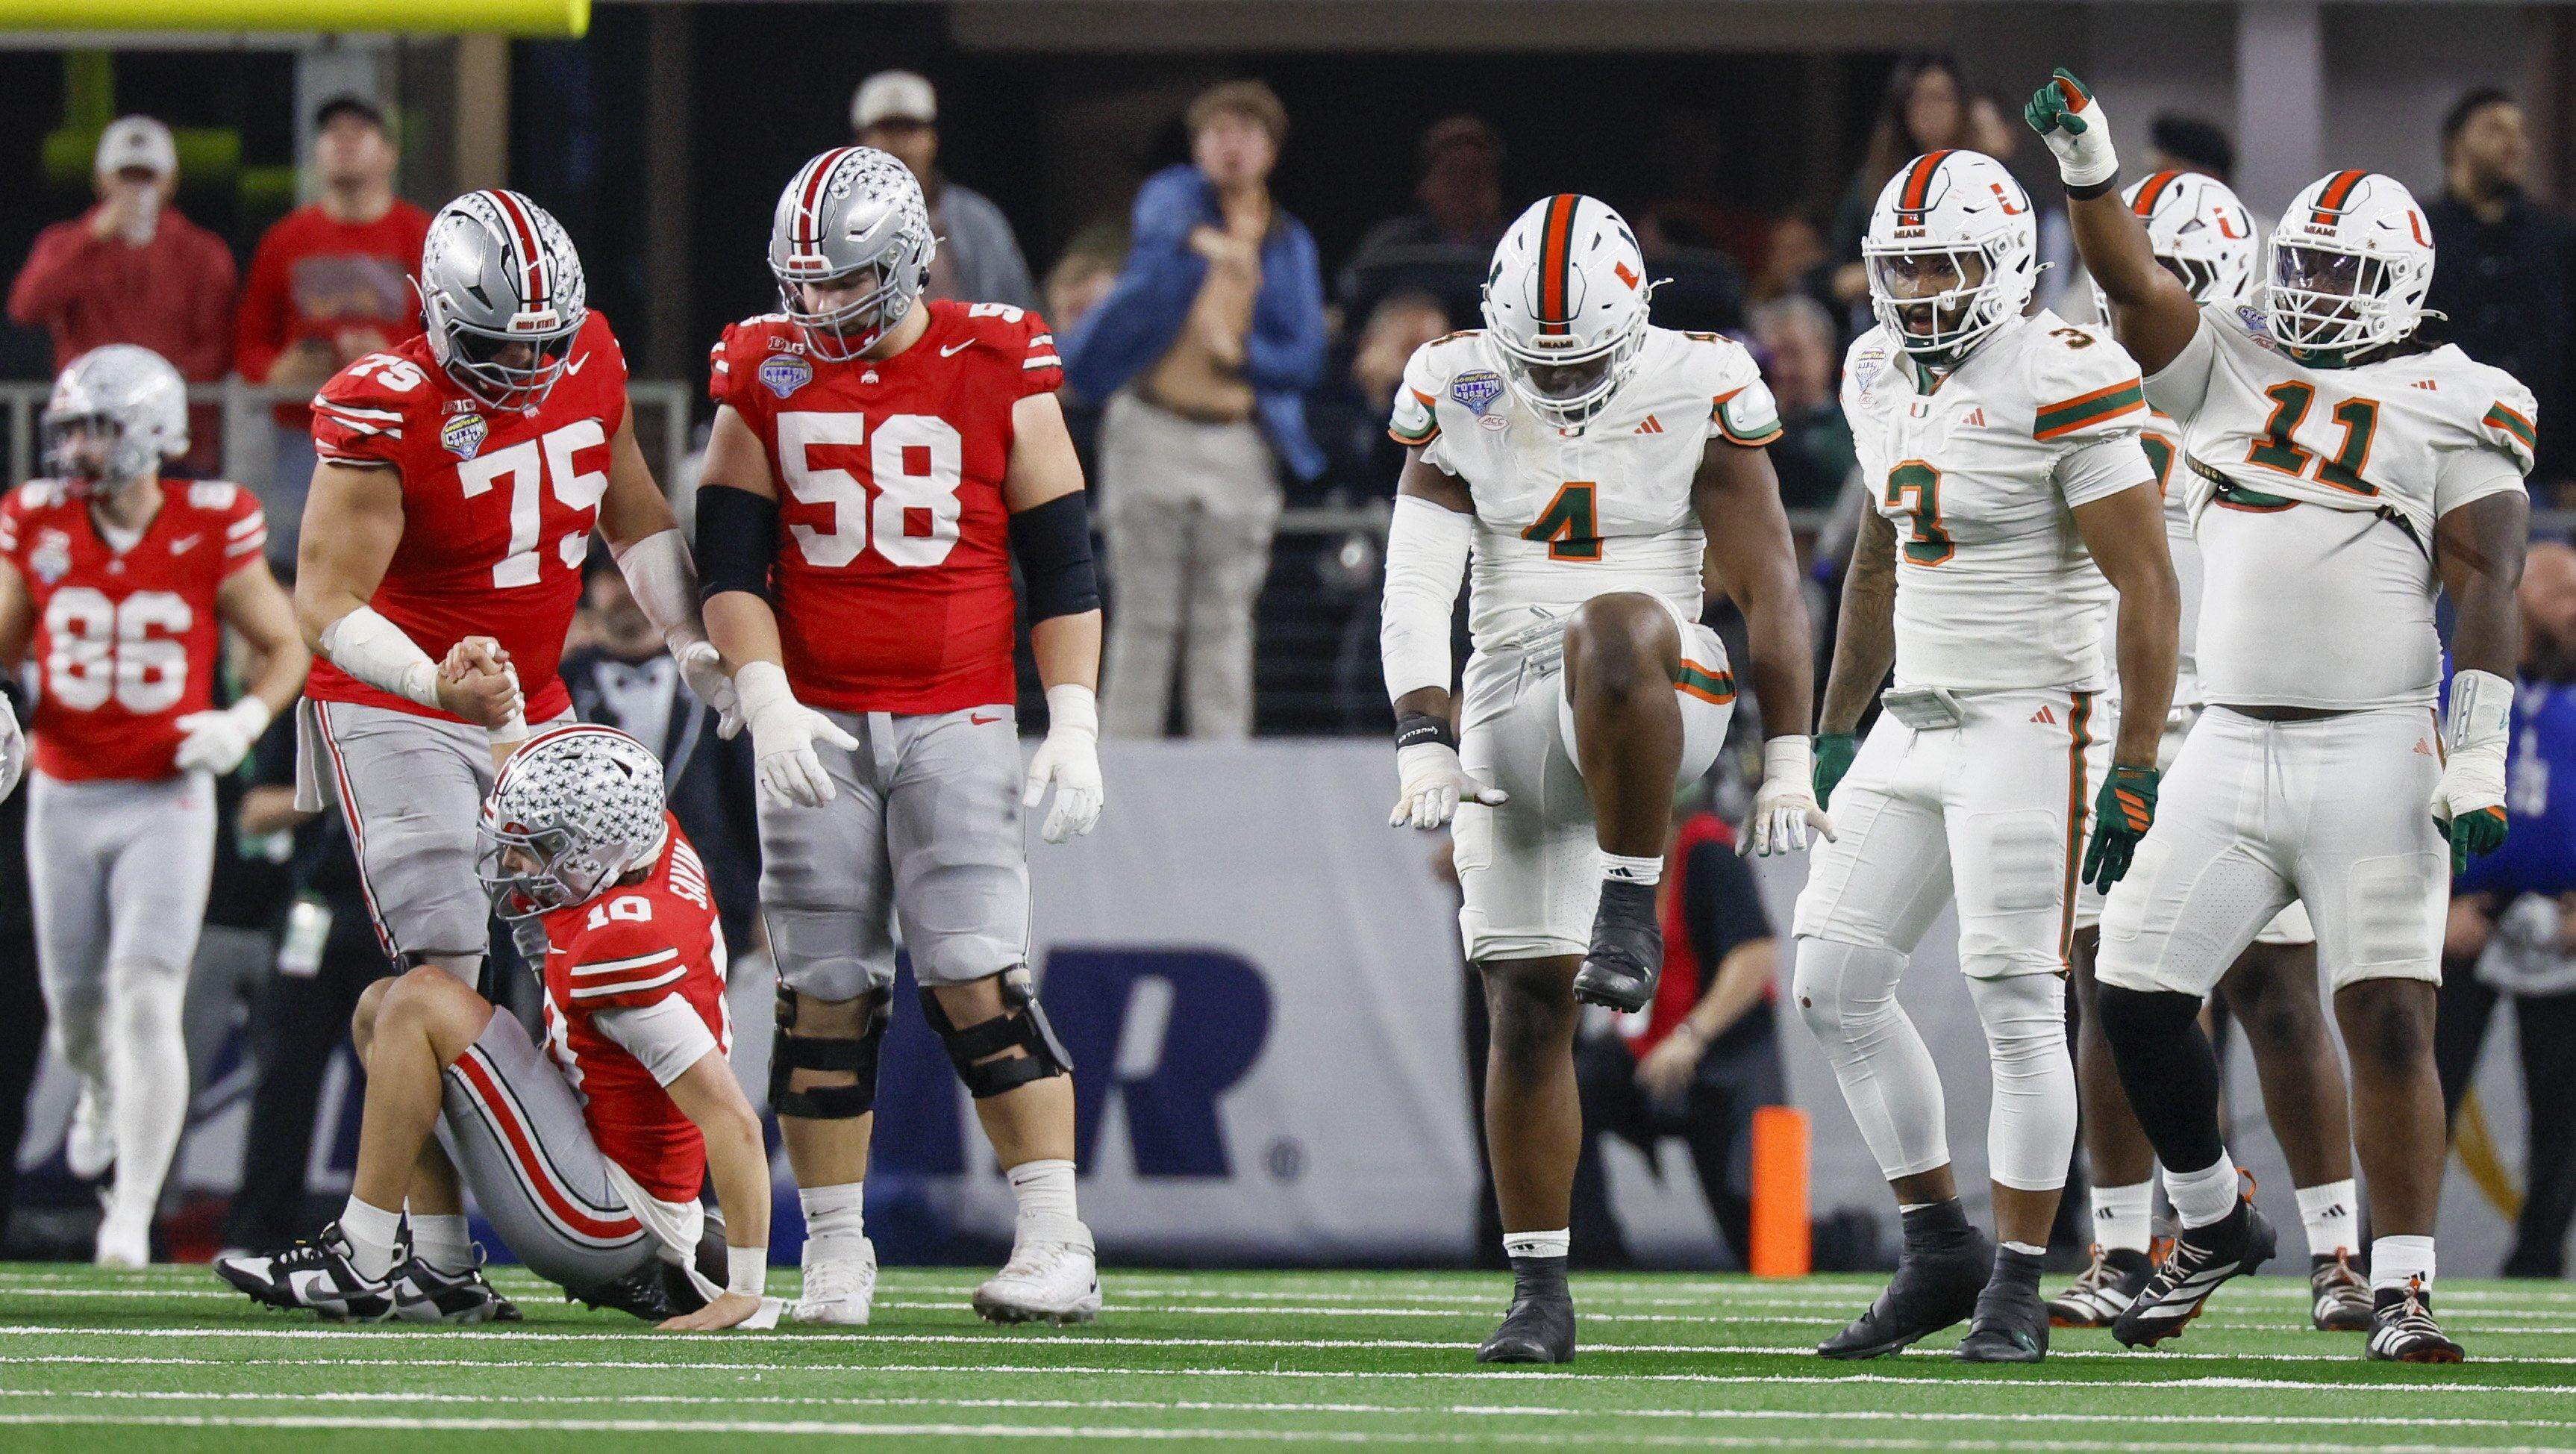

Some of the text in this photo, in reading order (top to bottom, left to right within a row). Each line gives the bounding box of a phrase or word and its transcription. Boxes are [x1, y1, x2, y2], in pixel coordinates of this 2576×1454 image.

[1894, 228, 1925, 239] MIAMI
[2304, 225, 2336, 237] MIAMI
[347, 353, 431, 392] 75
[1538, 339, 1574, 349] MIAMI
[1454, 379, 1500, 398] COTTON
[2245, 379, 2380, 497] 11
[457, 416, 608, 589] 75
[777, 411, 963, 568] 58
[1884, 459, 1955, 567] 3
[1521, 481, 1605, 562] 4
[45, 585, 194, 714] 86
[587, 895, 652, 932] 10
